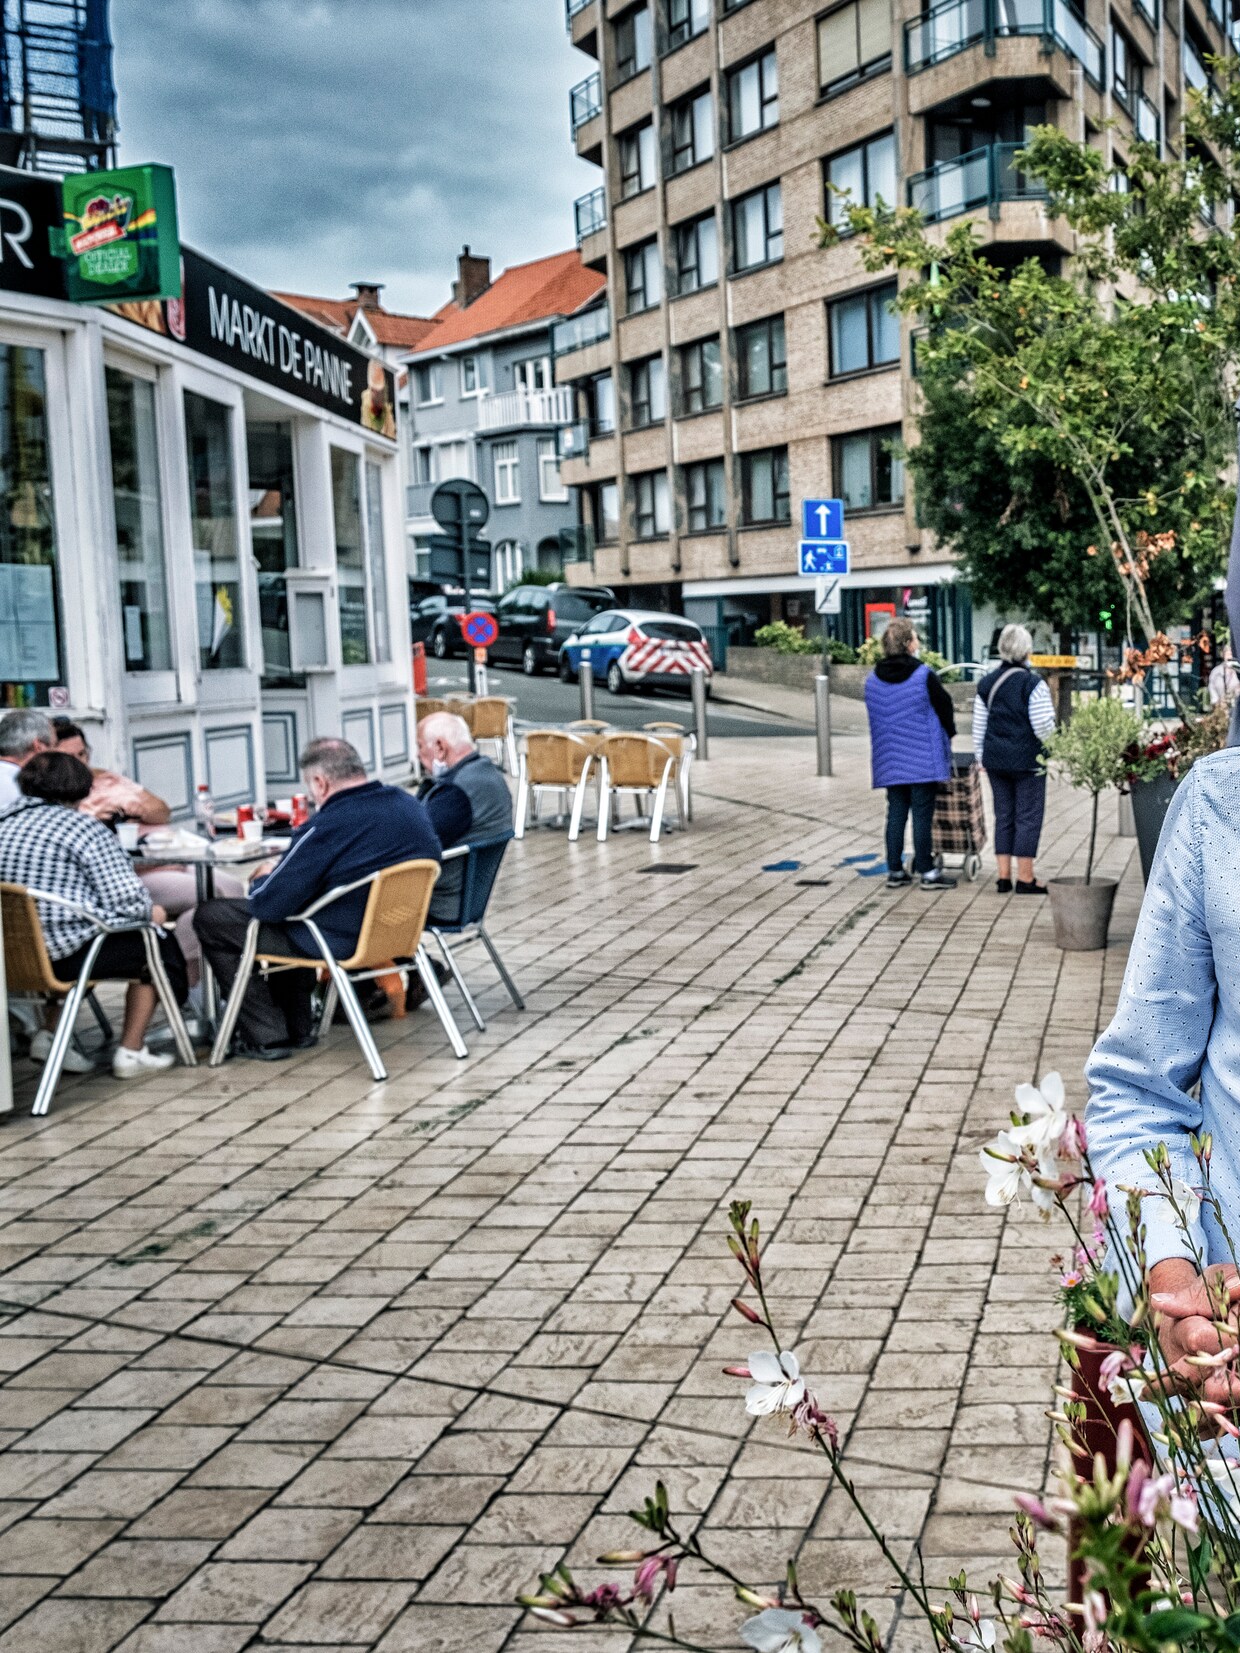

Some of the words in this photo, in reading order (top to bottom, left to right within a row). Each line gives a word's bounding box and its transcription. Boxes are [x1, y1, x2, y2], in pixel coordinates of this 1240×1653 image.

[208, 285, 276, 366] MARKT
[278, 325, 303, 379] DE
[304, 339, 354, 405] PANNE
